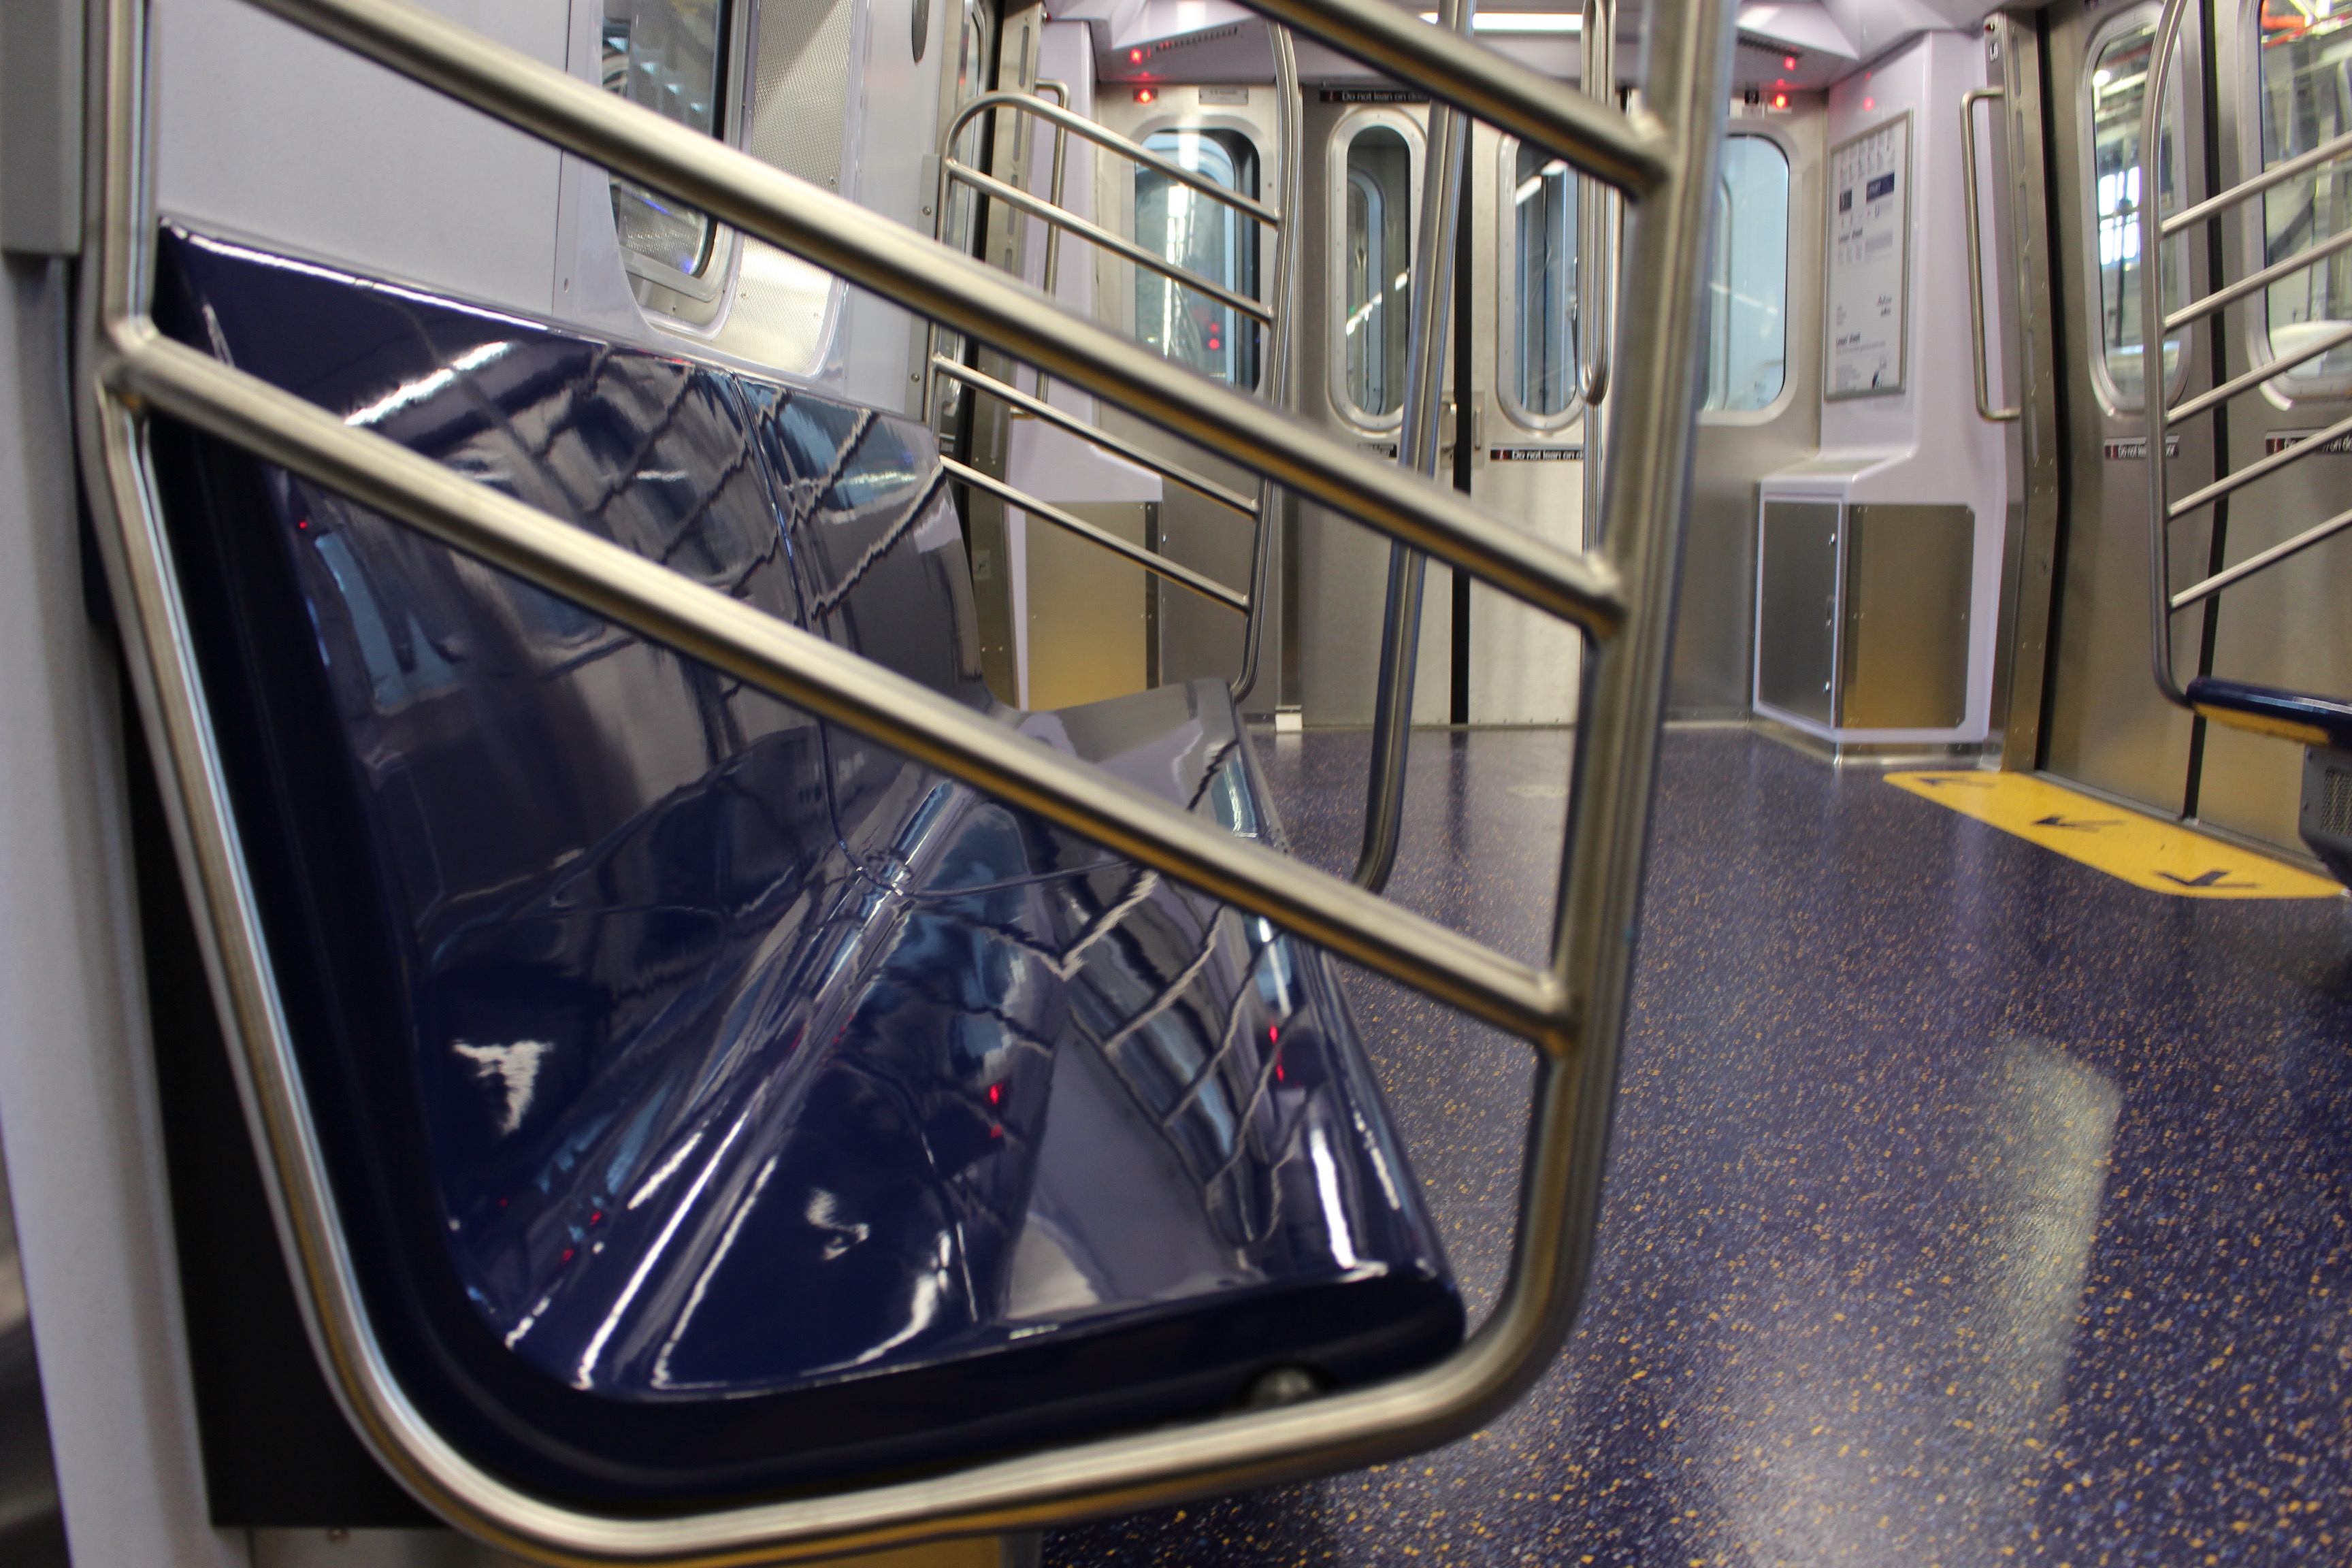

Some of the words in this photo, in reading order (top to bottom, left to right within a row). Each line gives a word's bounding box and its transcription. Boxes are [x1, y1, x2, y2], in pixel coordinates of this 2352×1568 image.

[1342, 91, 1355, 101] Do
[1357, 91, 1372, 101] not
[1374, 91, 1392, 101] lean
[1394, 93, 1406, 101] on
[1512, 449, 1525, 460] Do
[1526, 449, 1541, 460] not
[1543, 449, 1561, 460] lean
[1563, 451, 1573, 460] on
